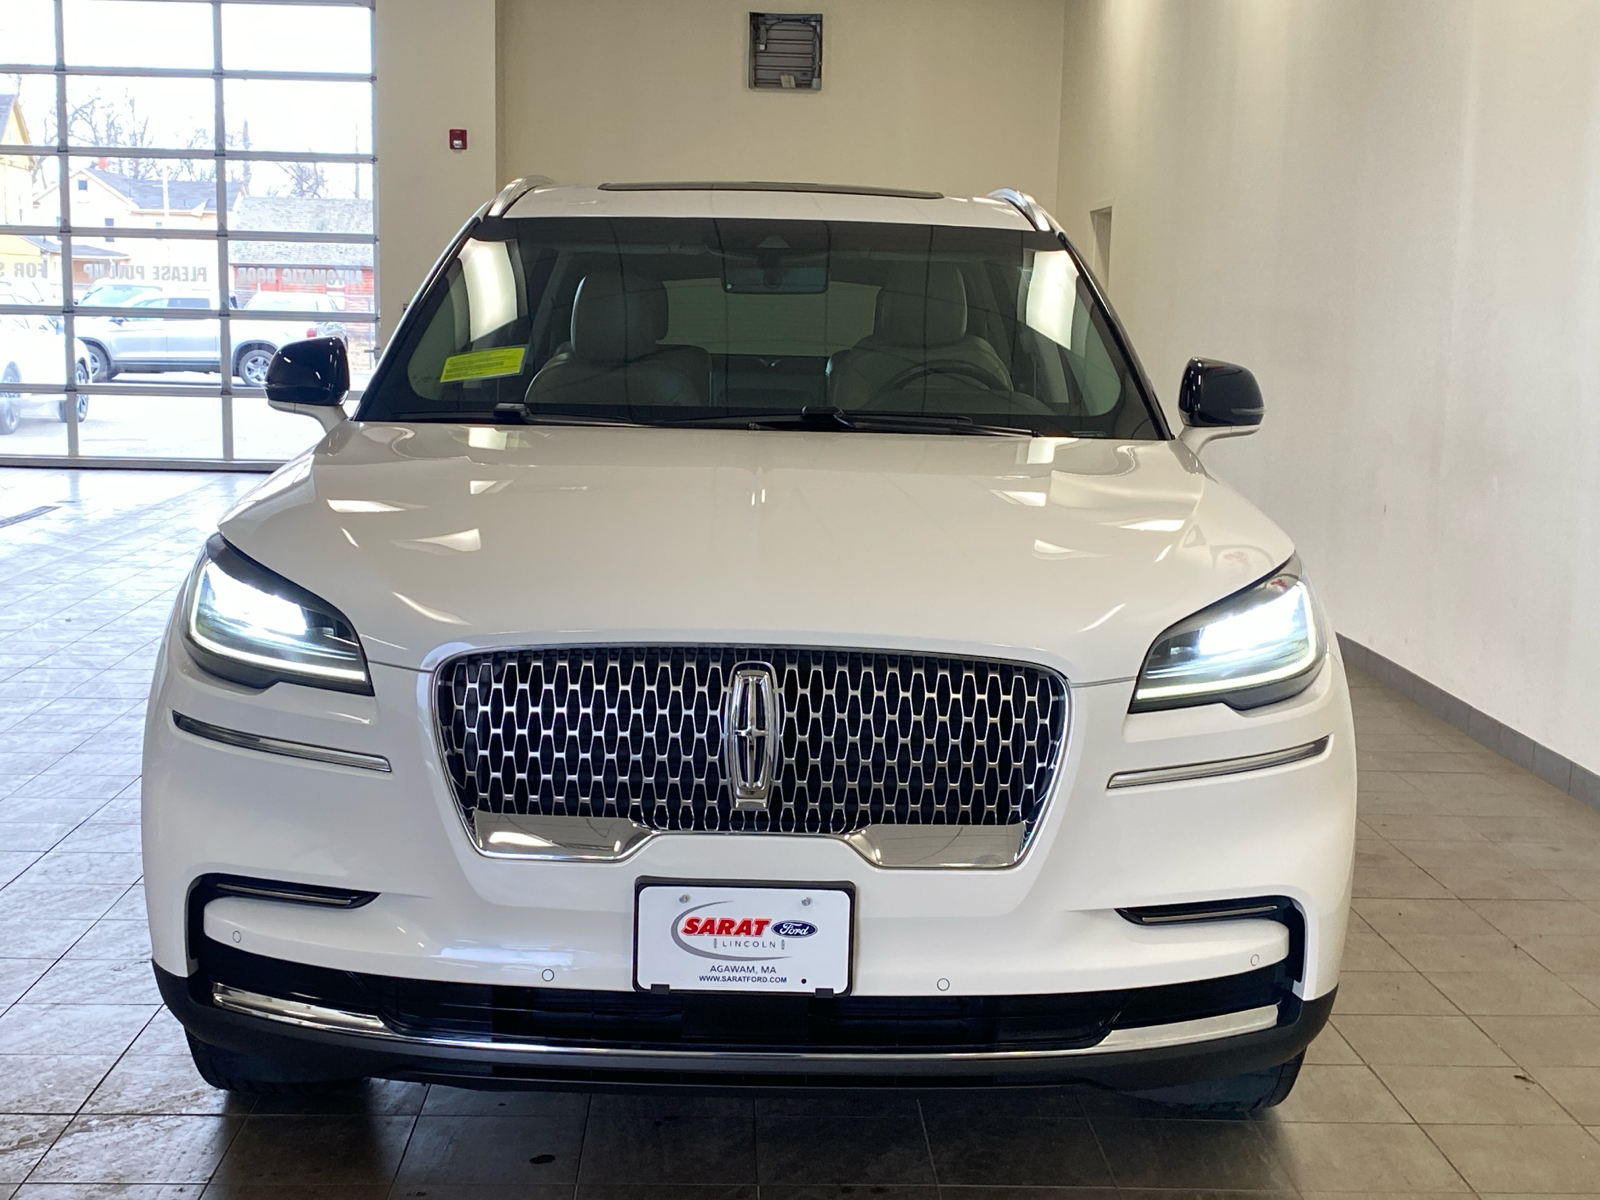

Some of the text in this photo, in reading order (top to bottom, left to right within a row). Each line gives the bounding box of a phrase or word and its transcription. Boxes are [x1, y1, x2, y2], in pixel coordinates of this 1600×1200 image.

[681, 917, 811, 937] SARAT Ford
[722, 940, 776, 949] LINCOLN
[709, 965, 777, 974] AGAWAM, MA
[698, 975, 787, 984] WWW.SARATFORD.COM
